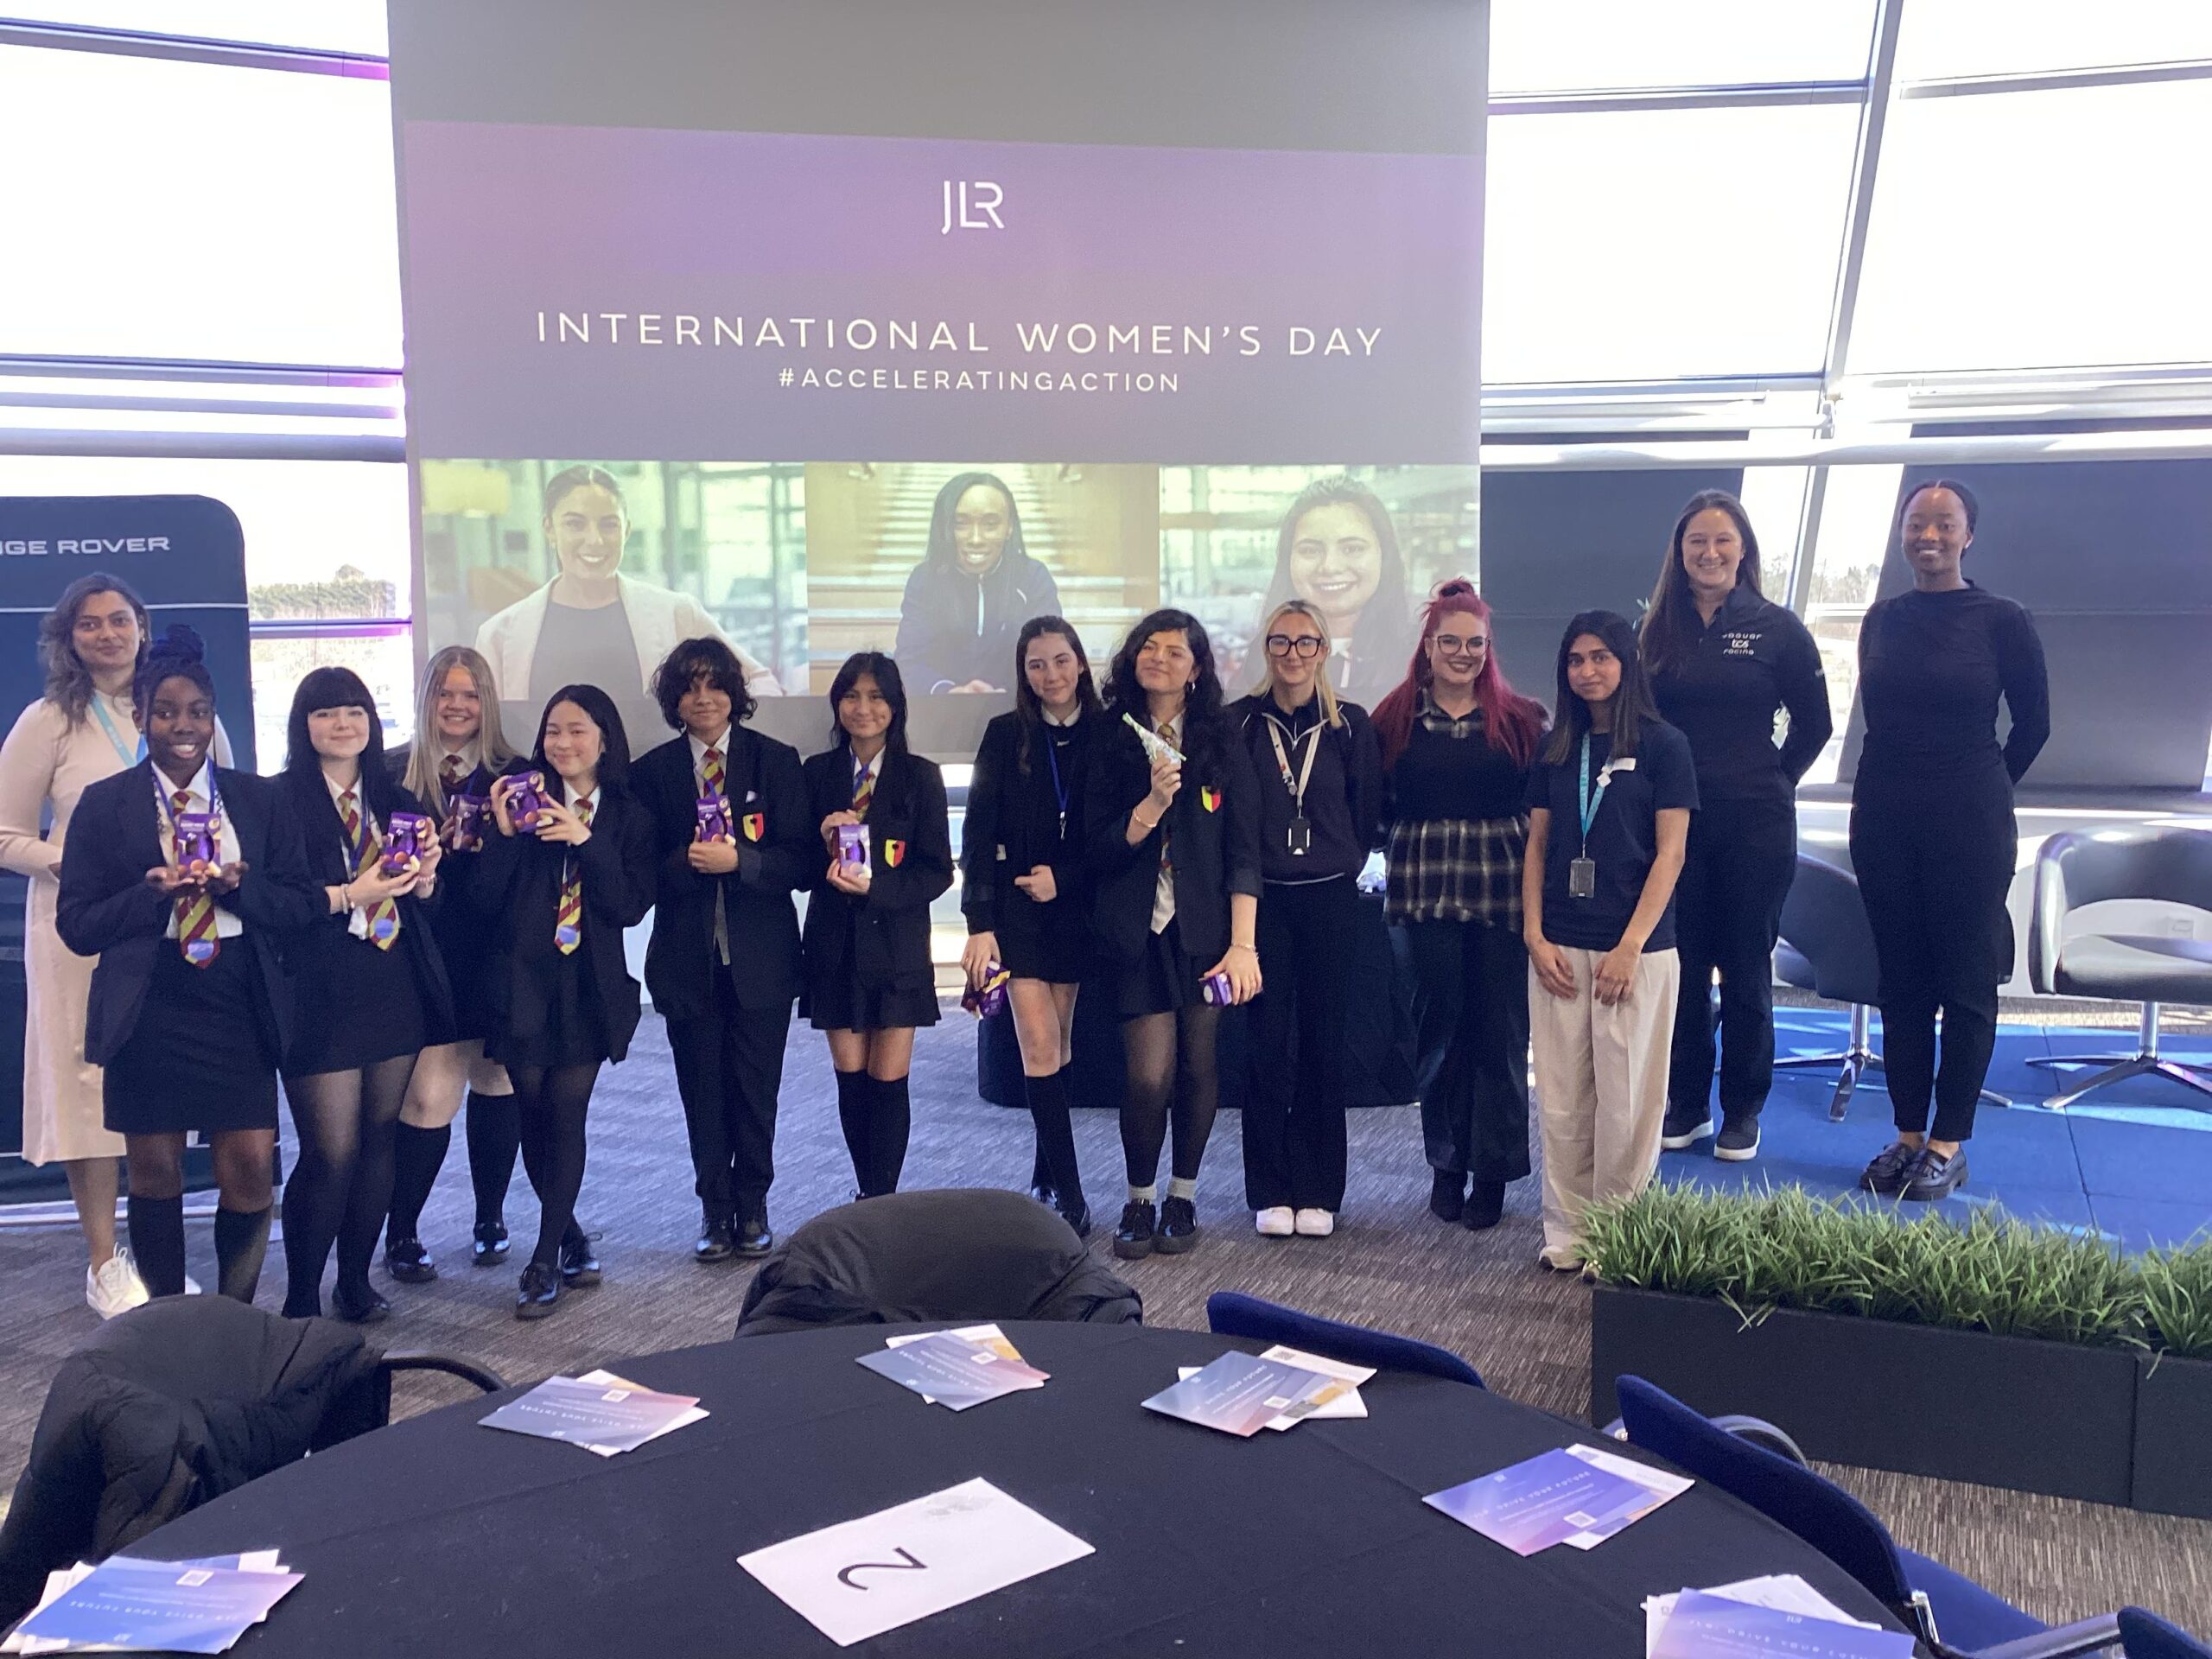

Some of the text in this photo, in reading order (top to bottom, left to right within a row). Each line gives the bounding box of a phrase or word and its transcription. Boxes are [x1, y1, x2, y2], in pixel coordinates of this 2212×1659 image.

[941, 180, 1005, 235] JLR
[537, 311, 1382, 357] INTERNATIONAL WOMEN'S DAY
[779, 367, 1178, 393] #ACCELERATINGACTION
[57, 536, 170, 555] ROVER
[837, 1547, 927, 1590] 2
